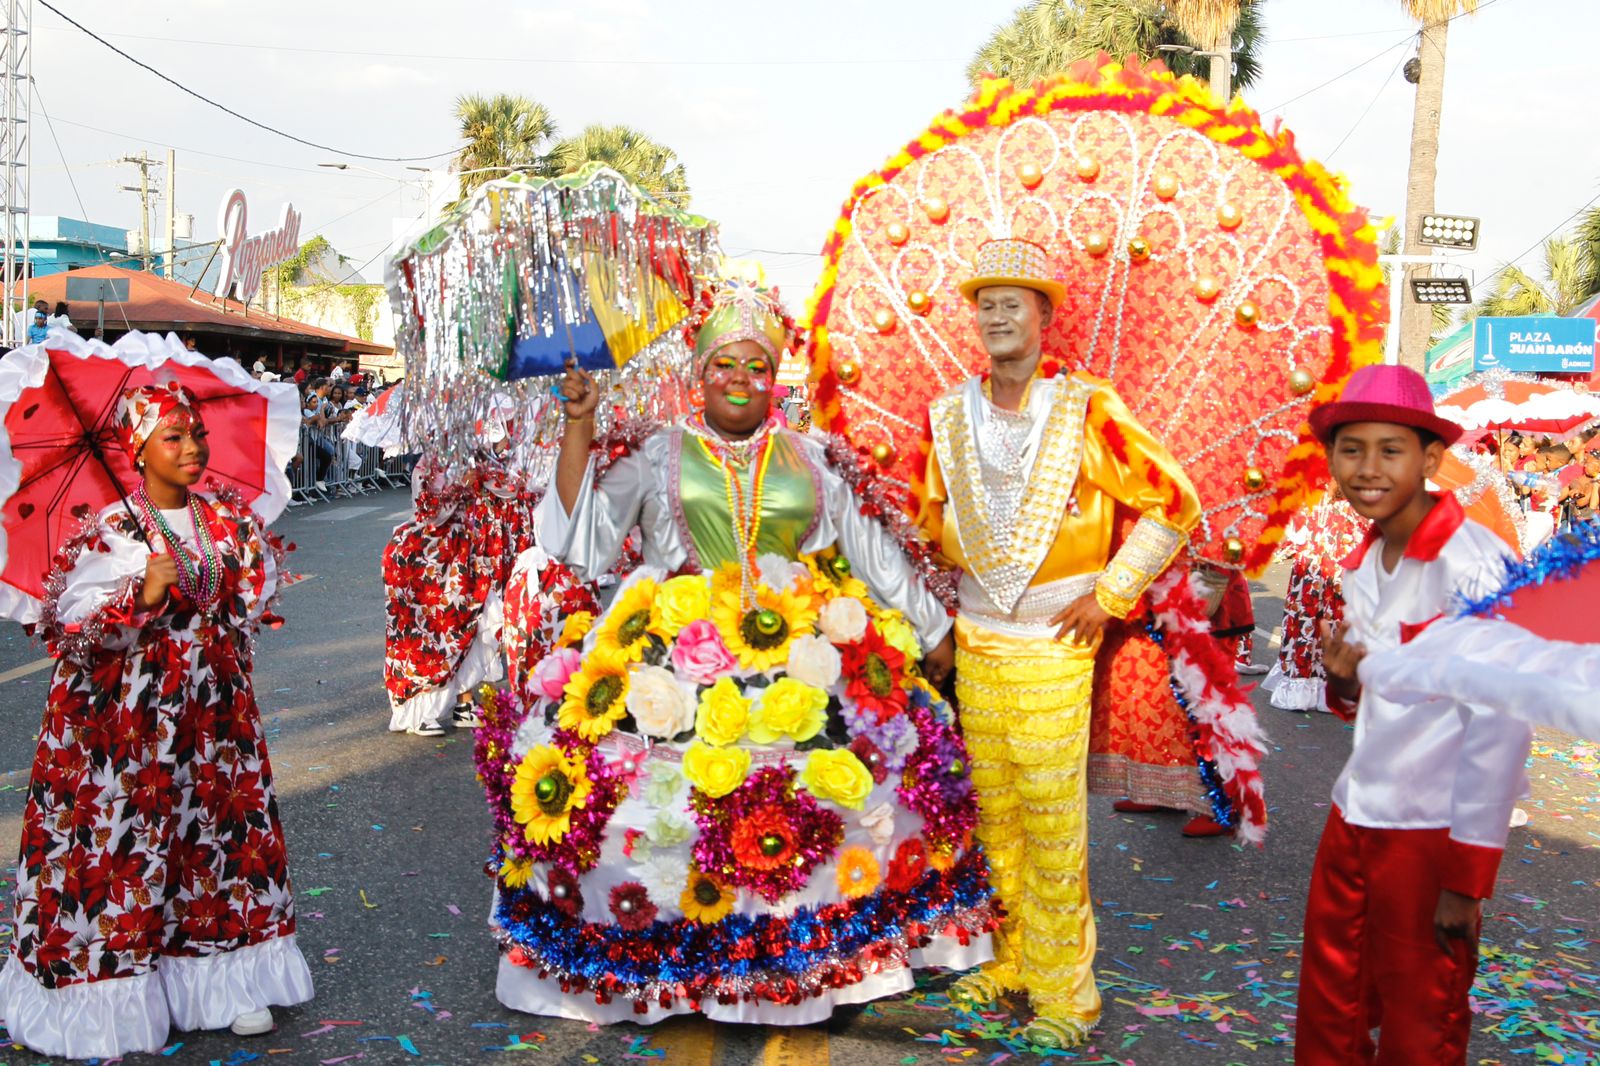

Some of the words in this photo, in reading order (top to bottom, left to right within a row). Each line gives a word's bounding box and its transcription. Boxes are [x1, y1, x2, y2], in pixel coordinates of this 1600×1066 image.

[1509, 332, 1552, 342] PLAZA
[1509, 344, 1544, 354] JUAN
[1546, 342, 1593, 355] BARÓN
